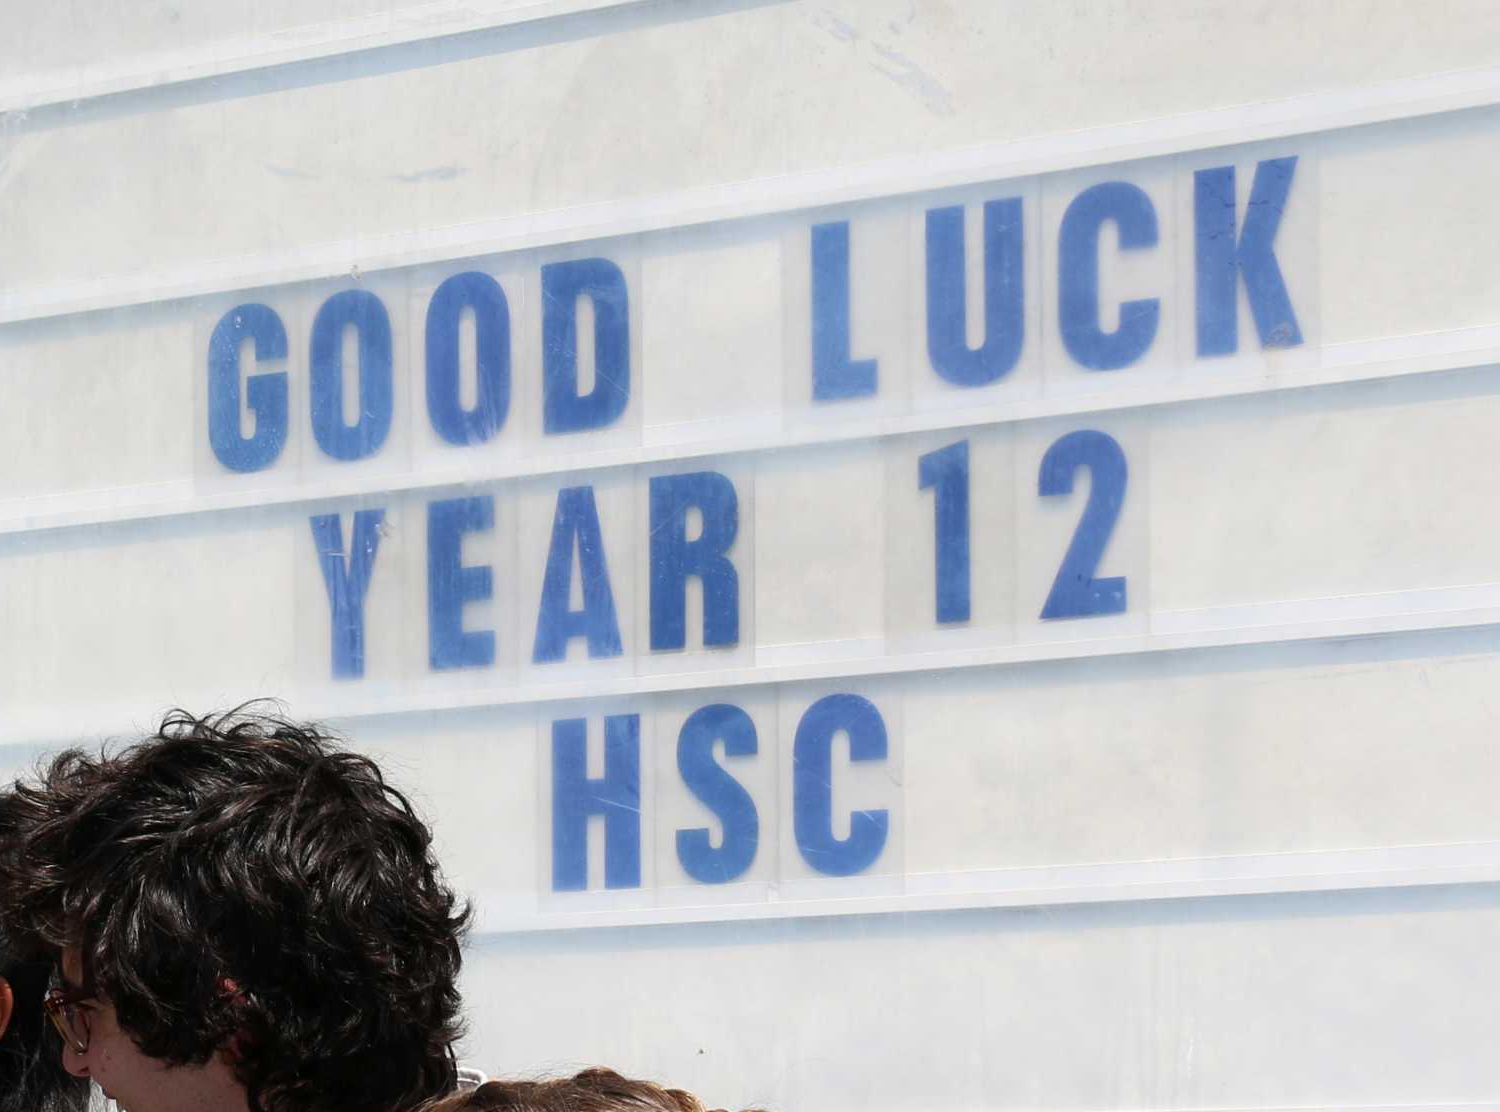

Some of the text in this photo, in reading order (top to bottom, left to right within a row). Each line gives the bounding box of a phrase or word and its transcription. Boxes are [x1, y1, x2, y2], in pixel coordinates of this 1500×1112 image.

[208, 156, 1303, 473] GOOD LUCK
[311, 430, 1128, 680] YEAR 12
[552, 694, 888, 892] HSC
